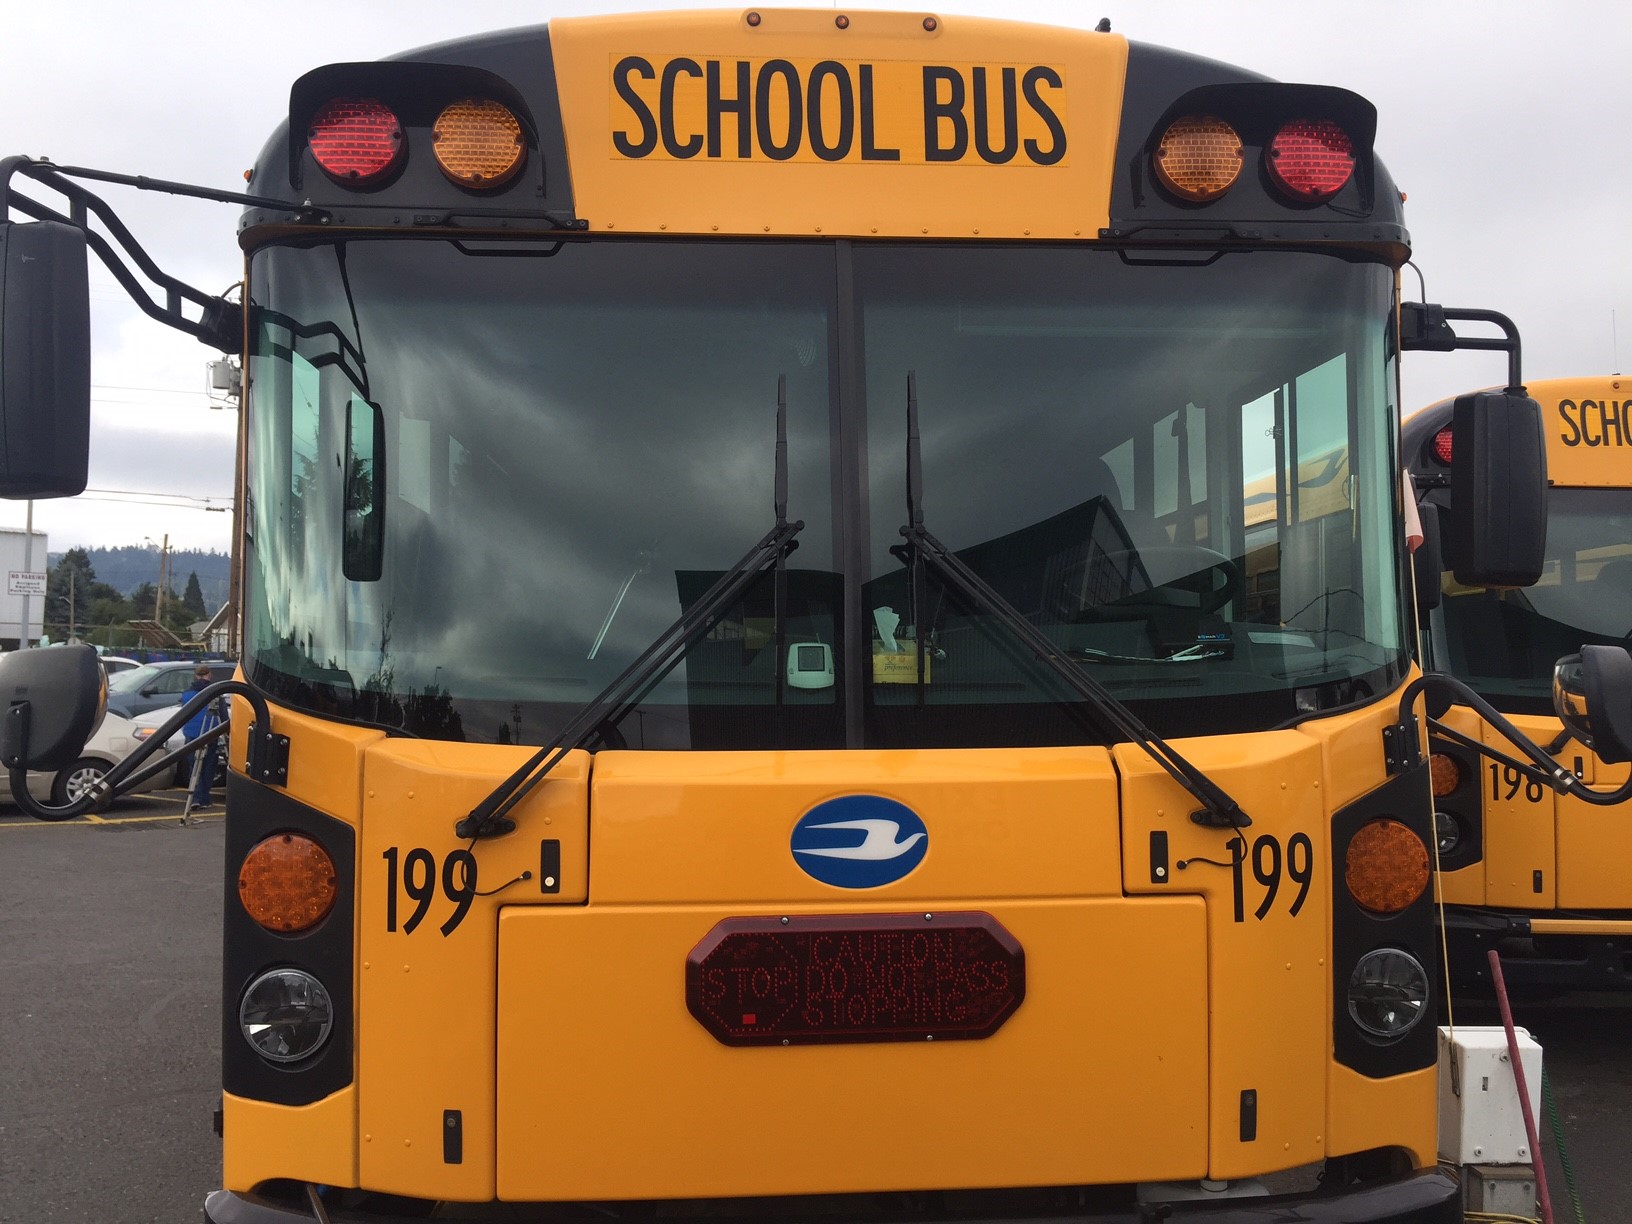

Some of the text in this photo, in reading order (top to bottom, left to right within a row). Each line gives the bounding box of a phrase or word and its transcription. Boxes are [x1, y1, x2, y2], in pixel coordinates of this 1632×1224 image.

[612, 55, 1068, 166] SCHOOL BUS
[1489, 763, 1543, 803] 198
[383, 846, 478, 938] 199
[1225, 832, 1313, 923] 199
[813, 933, 954, 966] CAUTION
[707, 967, 793, 1005] STOP
[806, 960, 1009, 999] DO NOT PASS
[805, 990, 967, 1026] STOPPING
